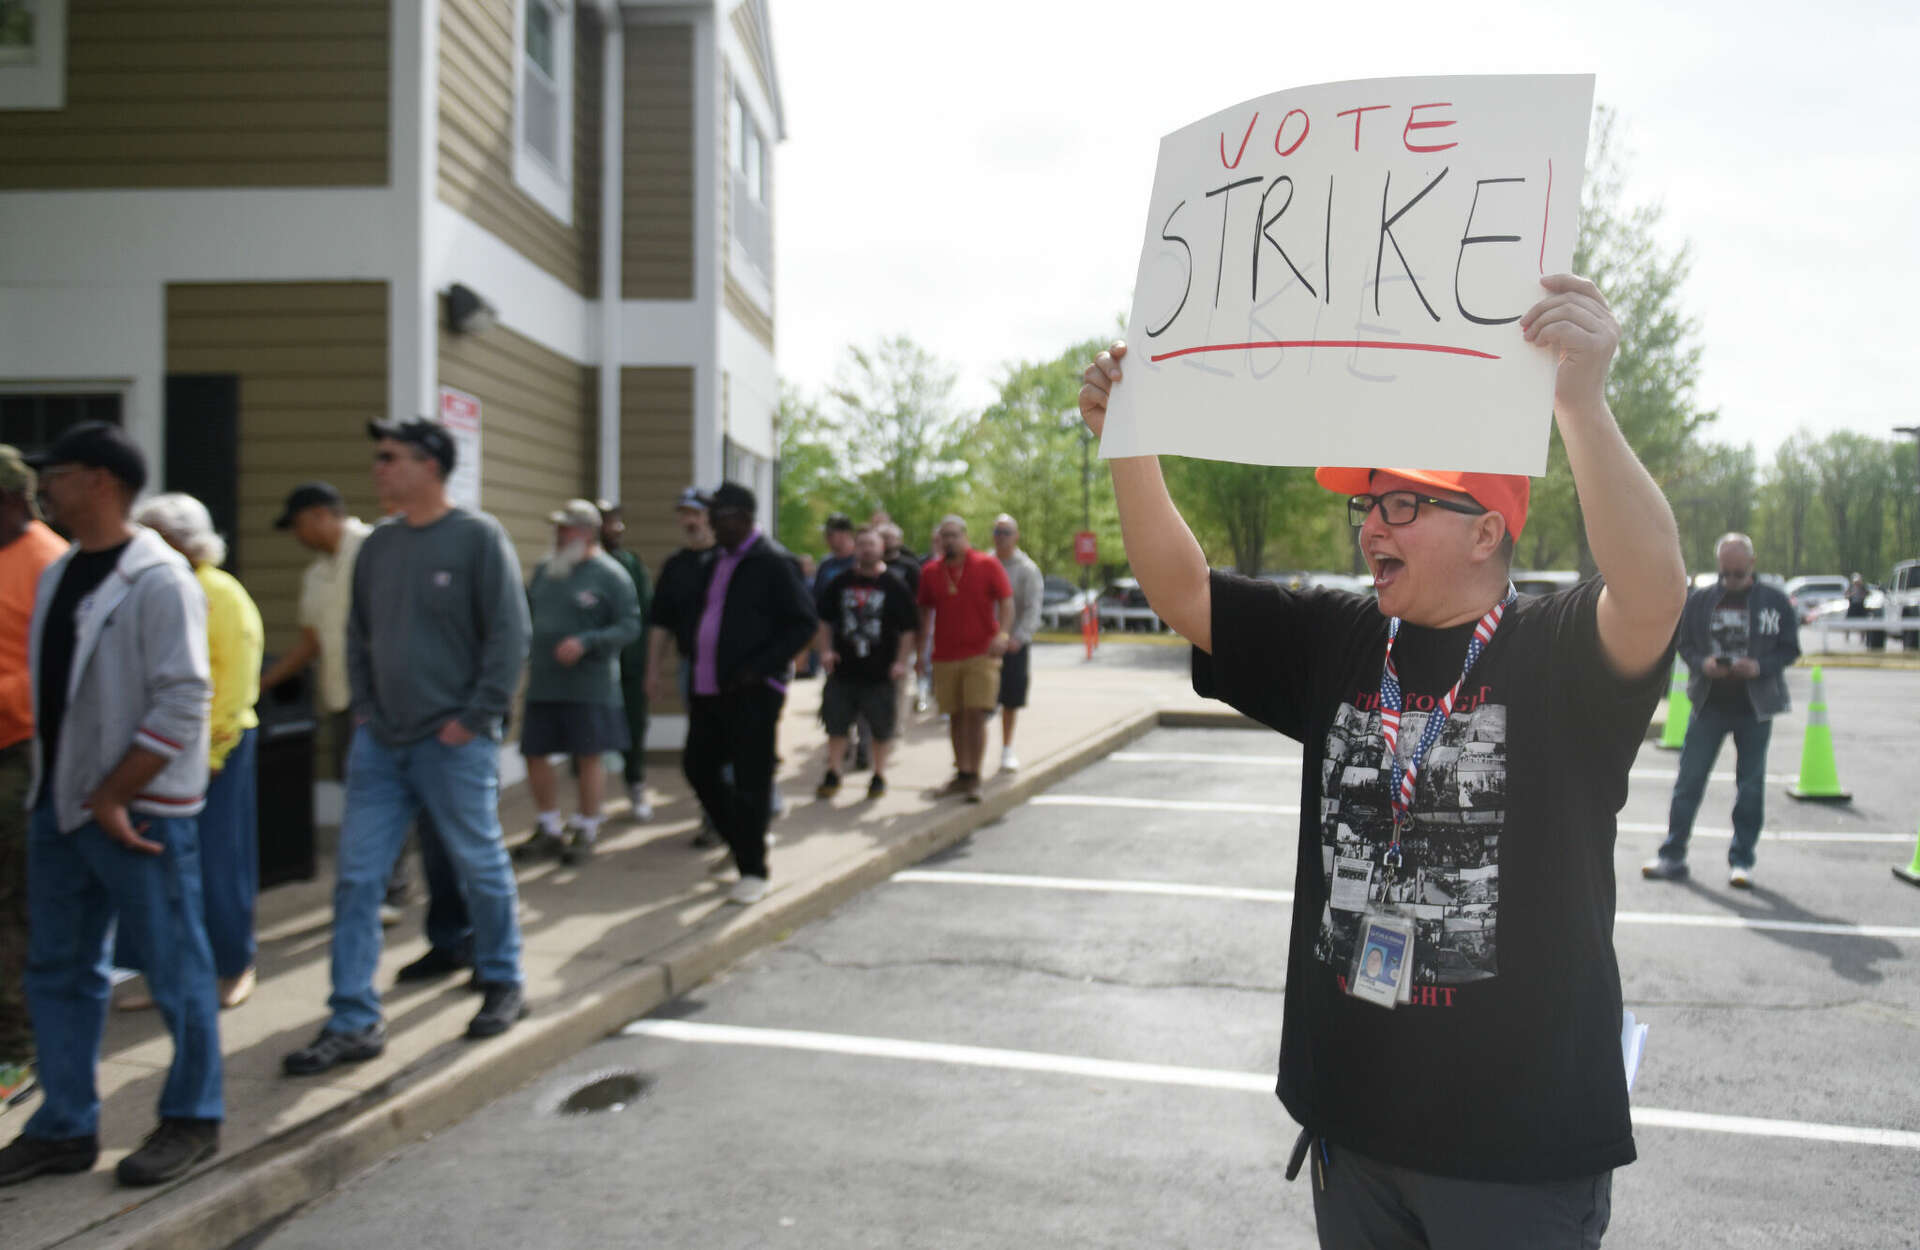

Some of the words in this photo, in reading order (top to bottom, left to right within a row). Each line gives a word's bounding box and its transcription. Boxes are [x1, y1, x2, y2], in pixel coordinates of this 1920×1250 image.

[1220, 102, 1459, 169] VOTE
[1145, 158, 1552, 338] STRIKE!
[1759, 608, 1780, 635] NY
